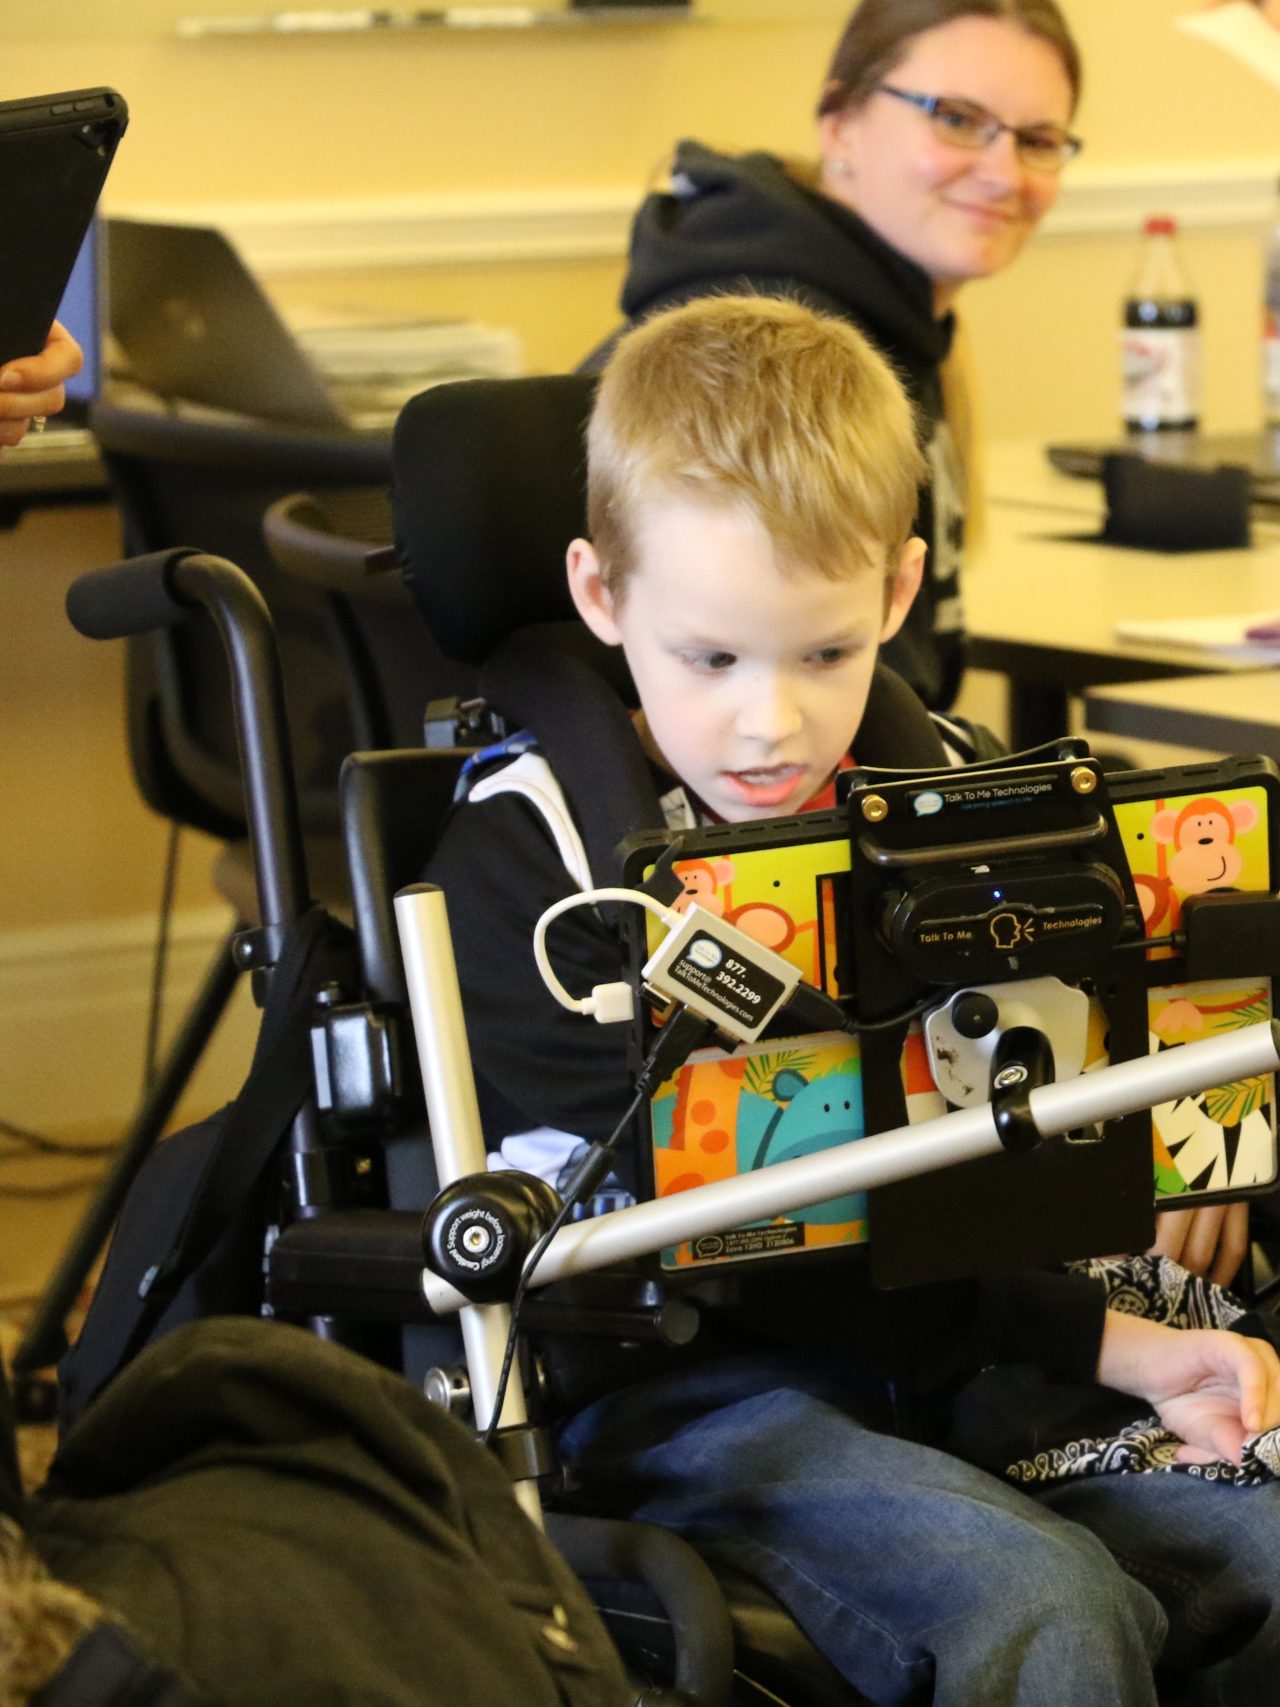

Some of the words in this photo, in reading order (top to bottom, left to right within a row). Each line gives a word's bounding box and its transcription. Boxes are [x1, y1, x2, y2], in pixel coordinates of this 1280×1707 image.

[944, 793, 963, 803] Talk
[965, 791, 975, 800] To
[977, 790, 991, 799] Me
[993, 783, 1052, 797] Technologies
[920, 934, 940, 943] Talk
[942, 932, 954, 941] To
[957, 931, 972, 940] Me
[1042, 916, 1103, 931] Technologies
[679, 959, 712, 984] support@
[725, 959, 747, 978] 877.
[674, 965, 754, 1022] TalkToMeTechnologies.com
[716, 971, 761, 1004] 392.2299
[460, 1209, 485, 1221] weight
[485, 1211, 503, 1235] before
[447, 1218, 461, 1249] Support
[449, 1249, 480, 1271] Caution!
